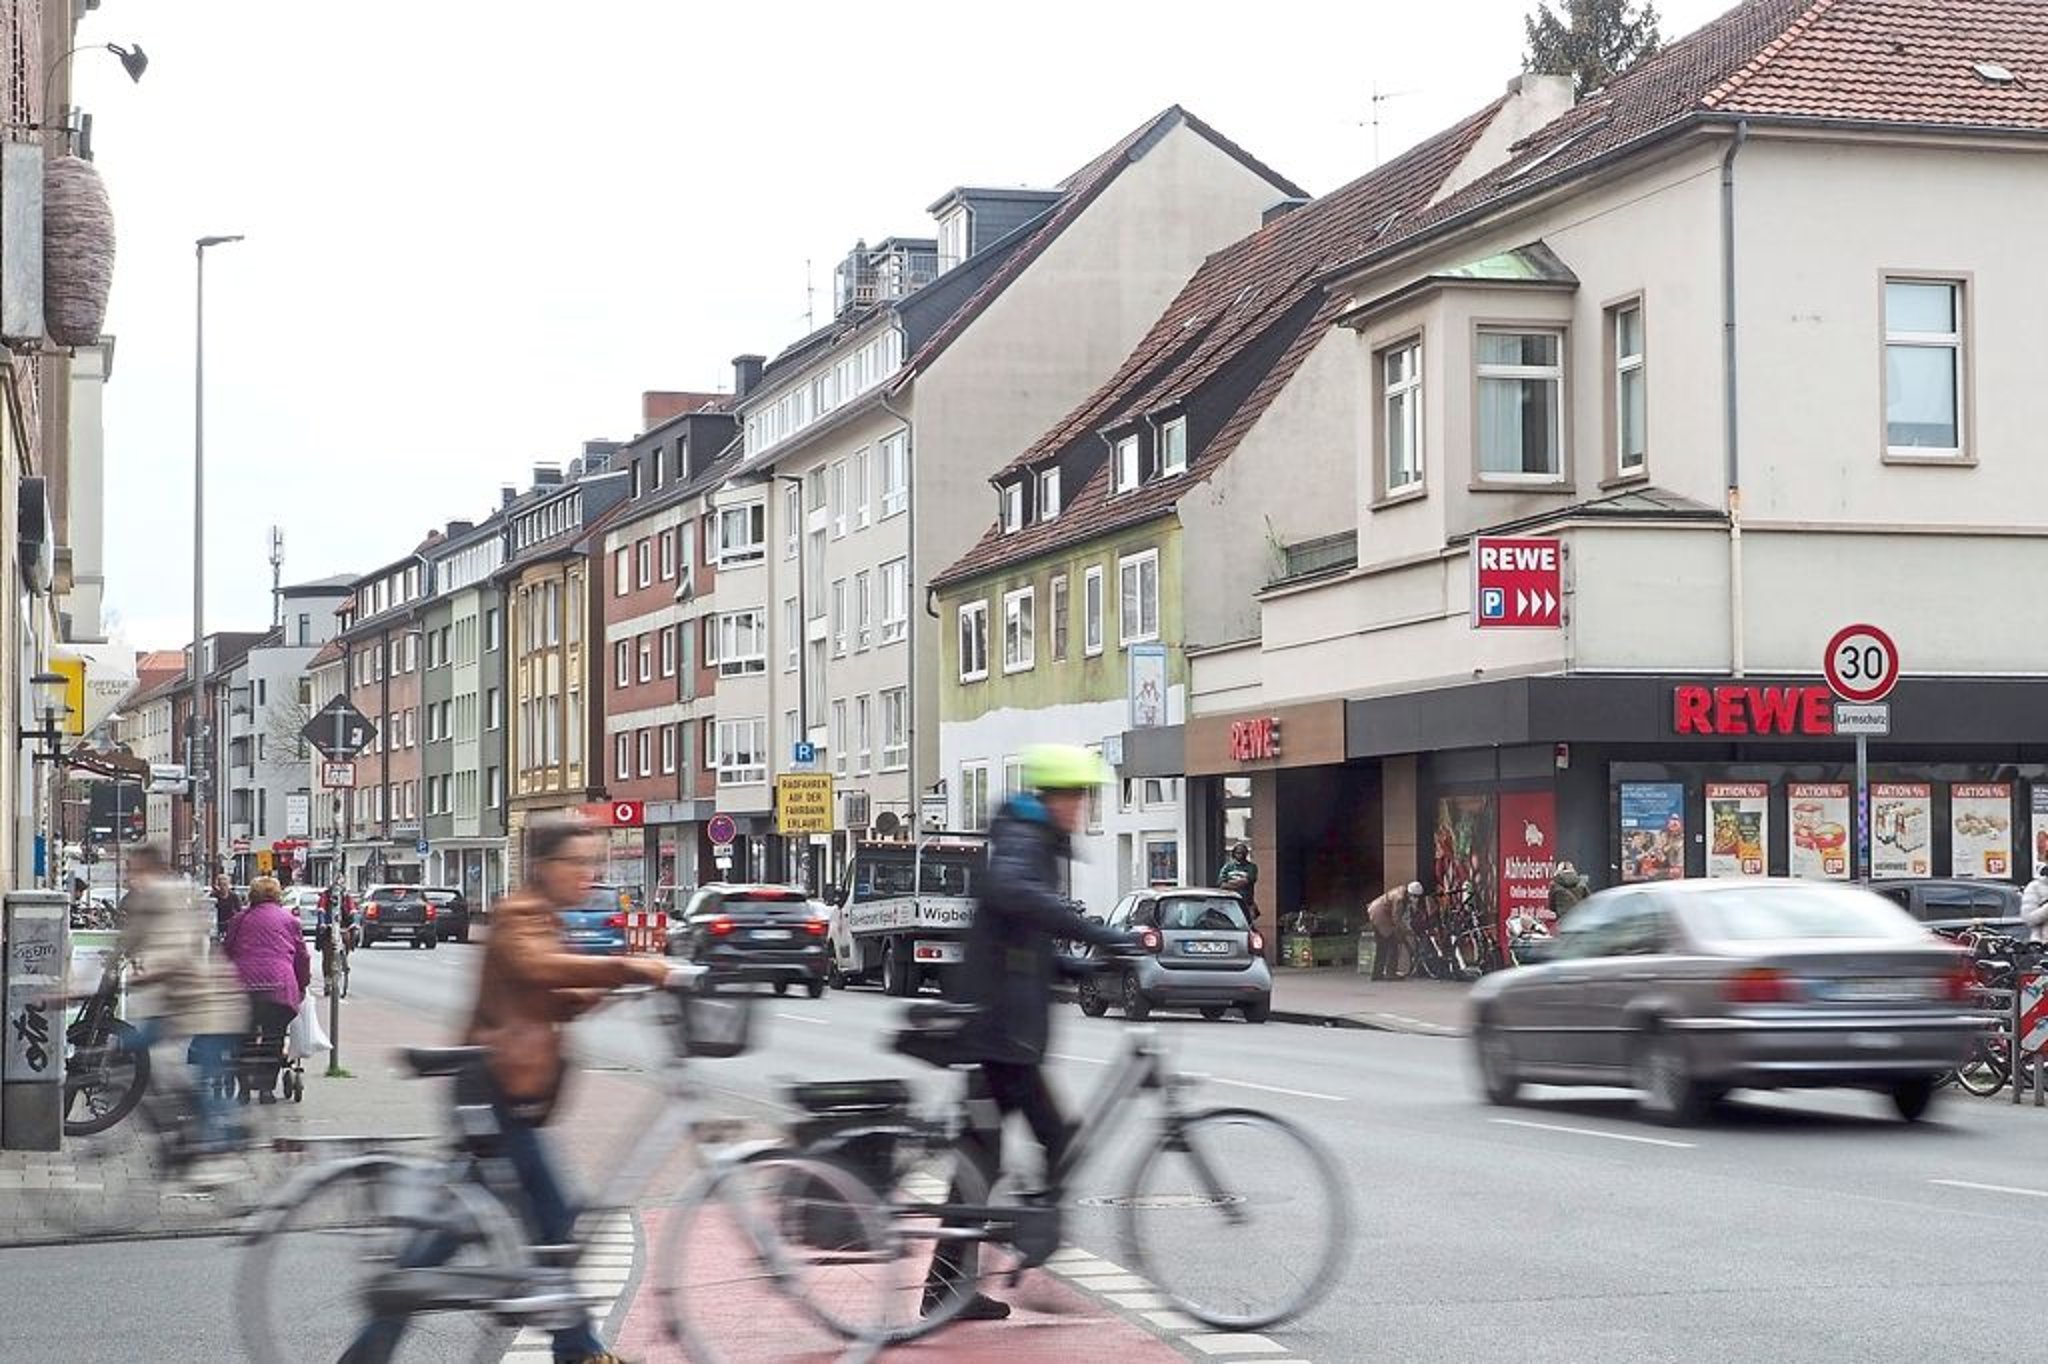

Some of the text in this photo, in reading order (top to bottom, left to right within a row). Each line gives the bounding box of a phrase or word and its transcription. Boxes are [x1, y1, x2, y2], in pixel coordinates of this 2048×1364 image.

[1481, 547, 1556, 571] REWE
[1485, 591, 1501, 615] P
[1841, 646, 1883, 680] 30
[1675, 685, 1833, 734] REWE
[1837, 711, 1886, 725] Lärmschutz
[1231, 717, 1280, 763] REWE
[782, 779, 828, 789] RADFAHREN
[1795, 785, 1828, 797] AKTION
[1877, 785, 1910, 797] AKTION
[789, 791, 822, 802] AUF DER
[1712, 786, 1746, 797] AKTION
[1957, 786, 1991, 797] AKTION
[786, 805, 825, 815] FAHRBAHN
[1504, 855, 1556, 880] Abholservi
[1528, 885, 1550, 899] bestelle
